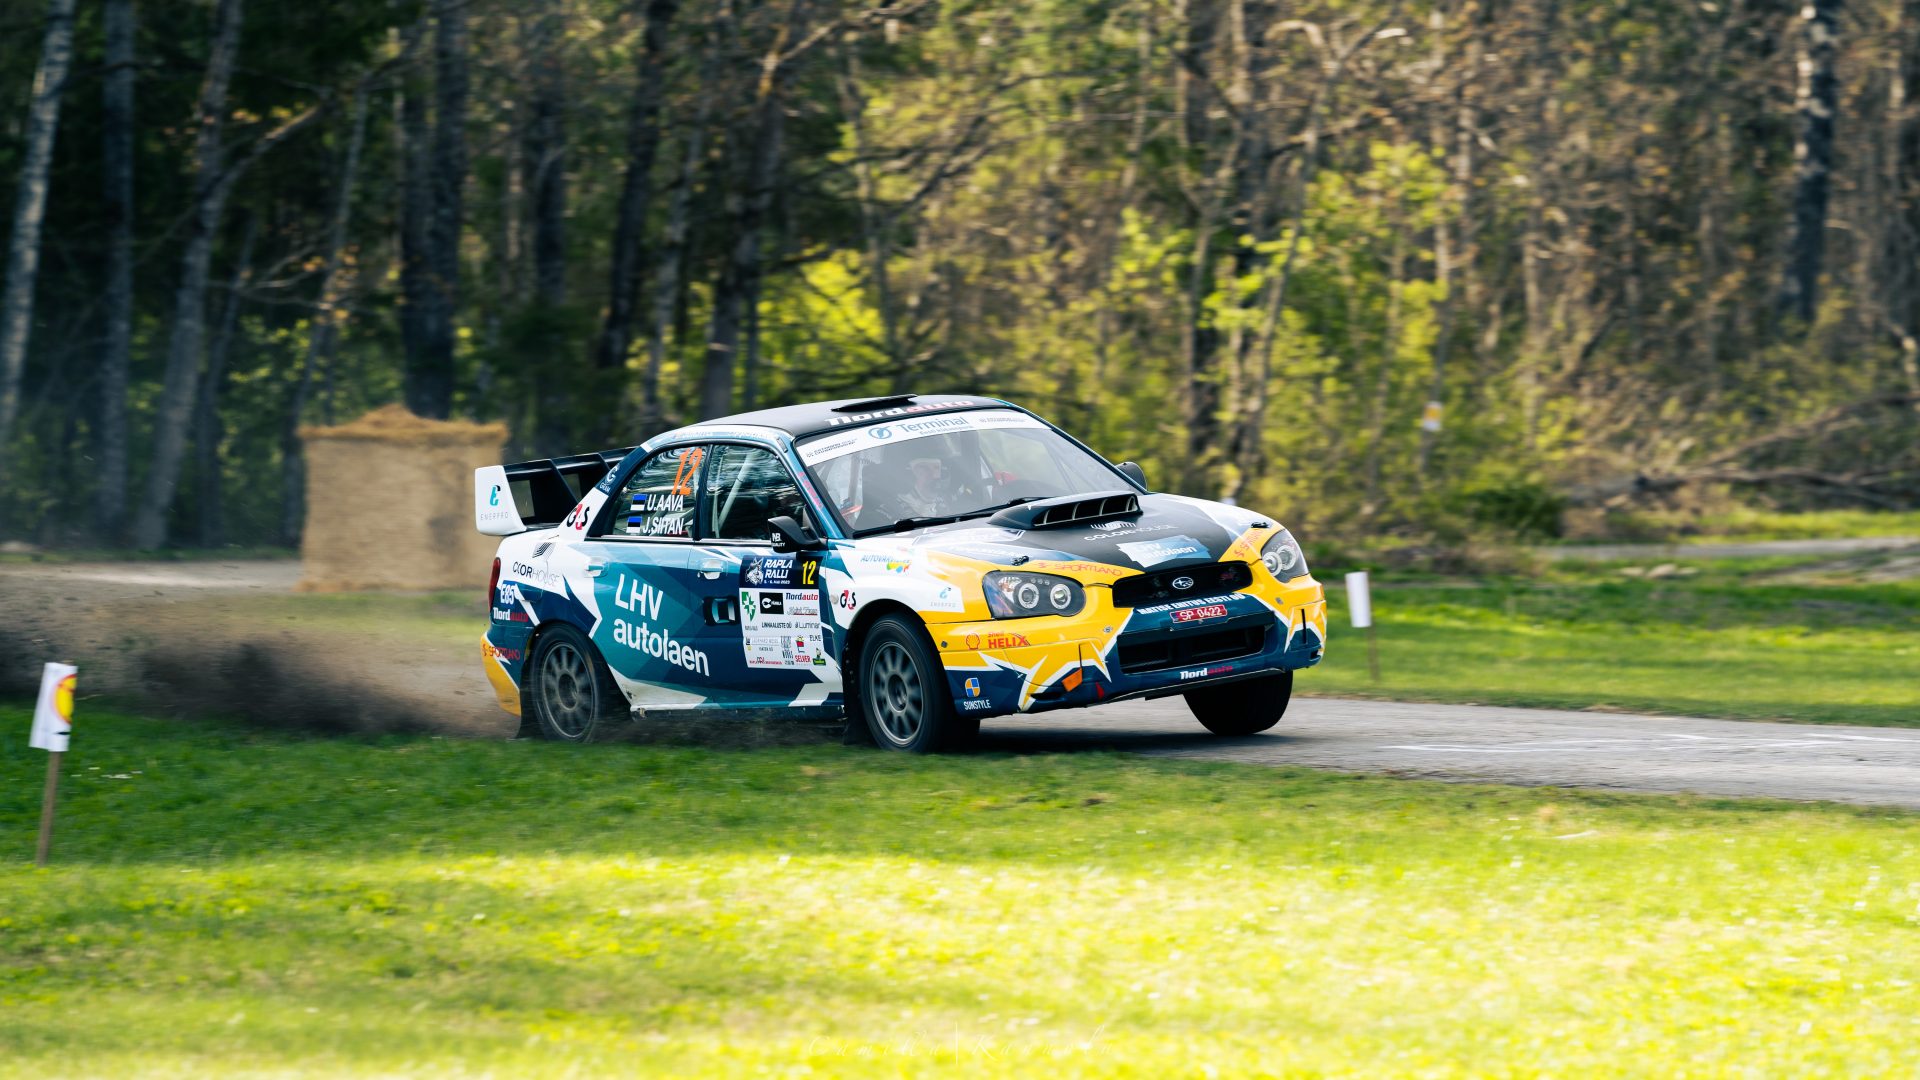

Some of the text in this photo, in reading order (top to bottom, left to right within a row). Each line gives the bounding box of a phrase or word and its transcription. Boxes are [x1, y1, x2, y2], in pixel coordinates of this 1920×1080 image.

[897, 416, 969, 433] Terminal
[671, 448, 702, 496] 12
[764, 560, 793, 568] RAPLA
[1054, 563, 1123, 577] SPORTLAND
[765, 570, 788, 579] RALLI
[802, 561, 817, 585] 12
[500, 584, 516, 604] E85
[615, 574, 663, 620] LHV
[786, 592, 818, 600] Nordauto
[1196, 607, 1222, 617] 0422
[613, 618, 710, 677] autolaen
[988, 635, 1031, 649] HELIX
[963, 700, 991, 710] SUNSTYLE
